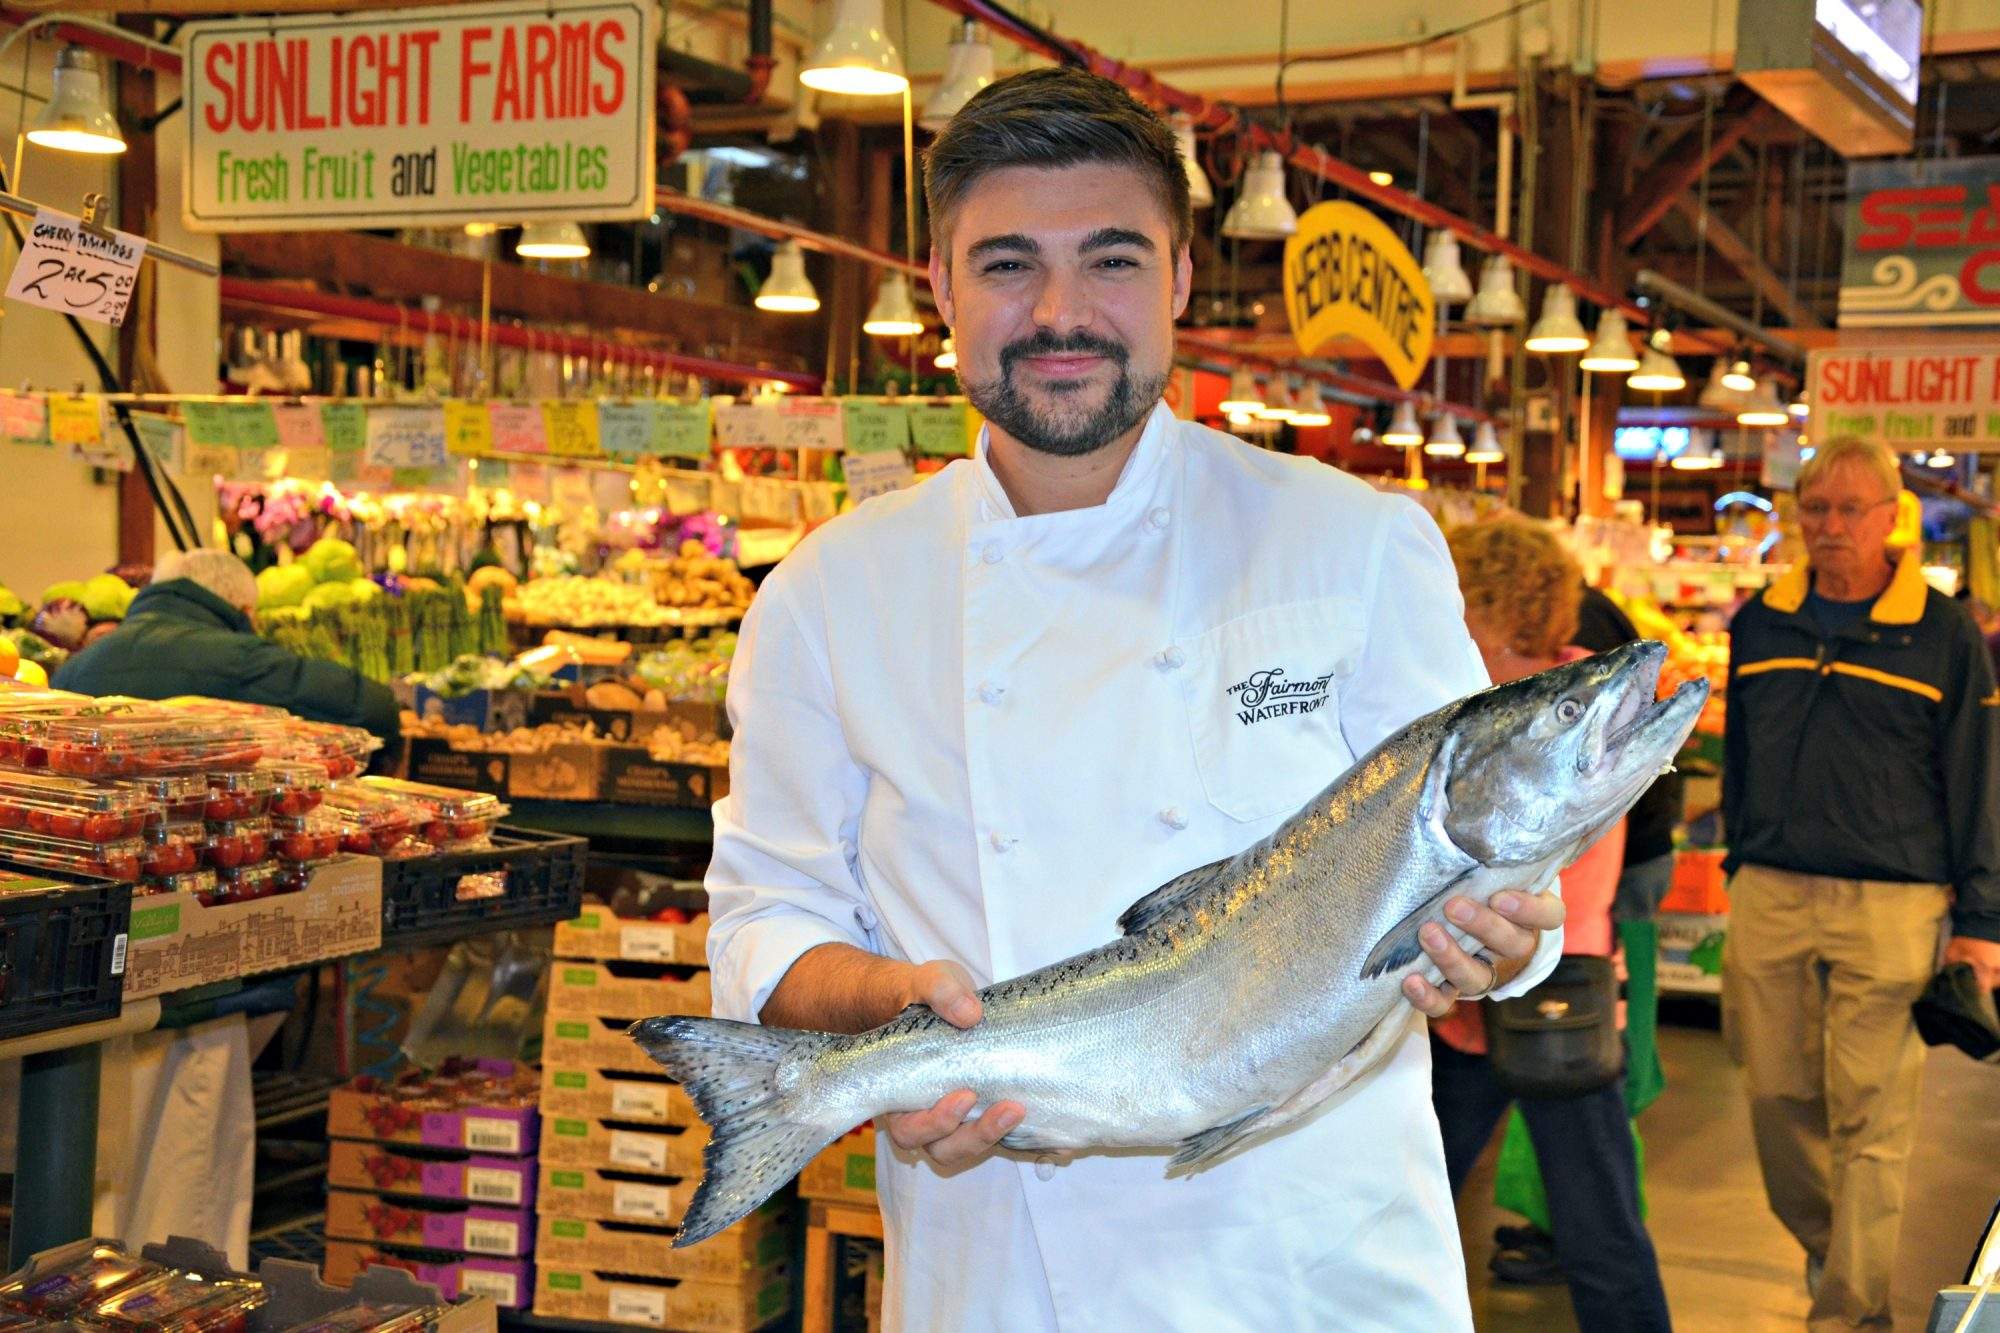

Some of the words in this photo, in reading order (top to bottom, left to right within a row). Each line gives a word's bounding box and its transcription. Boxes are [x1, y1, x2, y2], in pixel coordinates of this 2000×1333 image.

[203, 29, 440, 134] SUNLIGHT
[458, 19, 628, 123] FARMS
[217, 148, 289, 203] Fresh
[302, 145, 376, 201] Fruit
[391, 146, 437, 197] and
[451, 141, 608, 195] Vegetables
[33, 223, 77, 246] CHERRY
[1292, 231, 1342, 331] HERB
[1347, 233, 1425, 363] CENTRE
[1821, 356, 1981, 408] SUNLIGHT
[1226, 681, 1250, 696] THE
[1236, 694, 1330, 726] WATERFRONT
[1240, 667, 1335, 708] Fairmont
